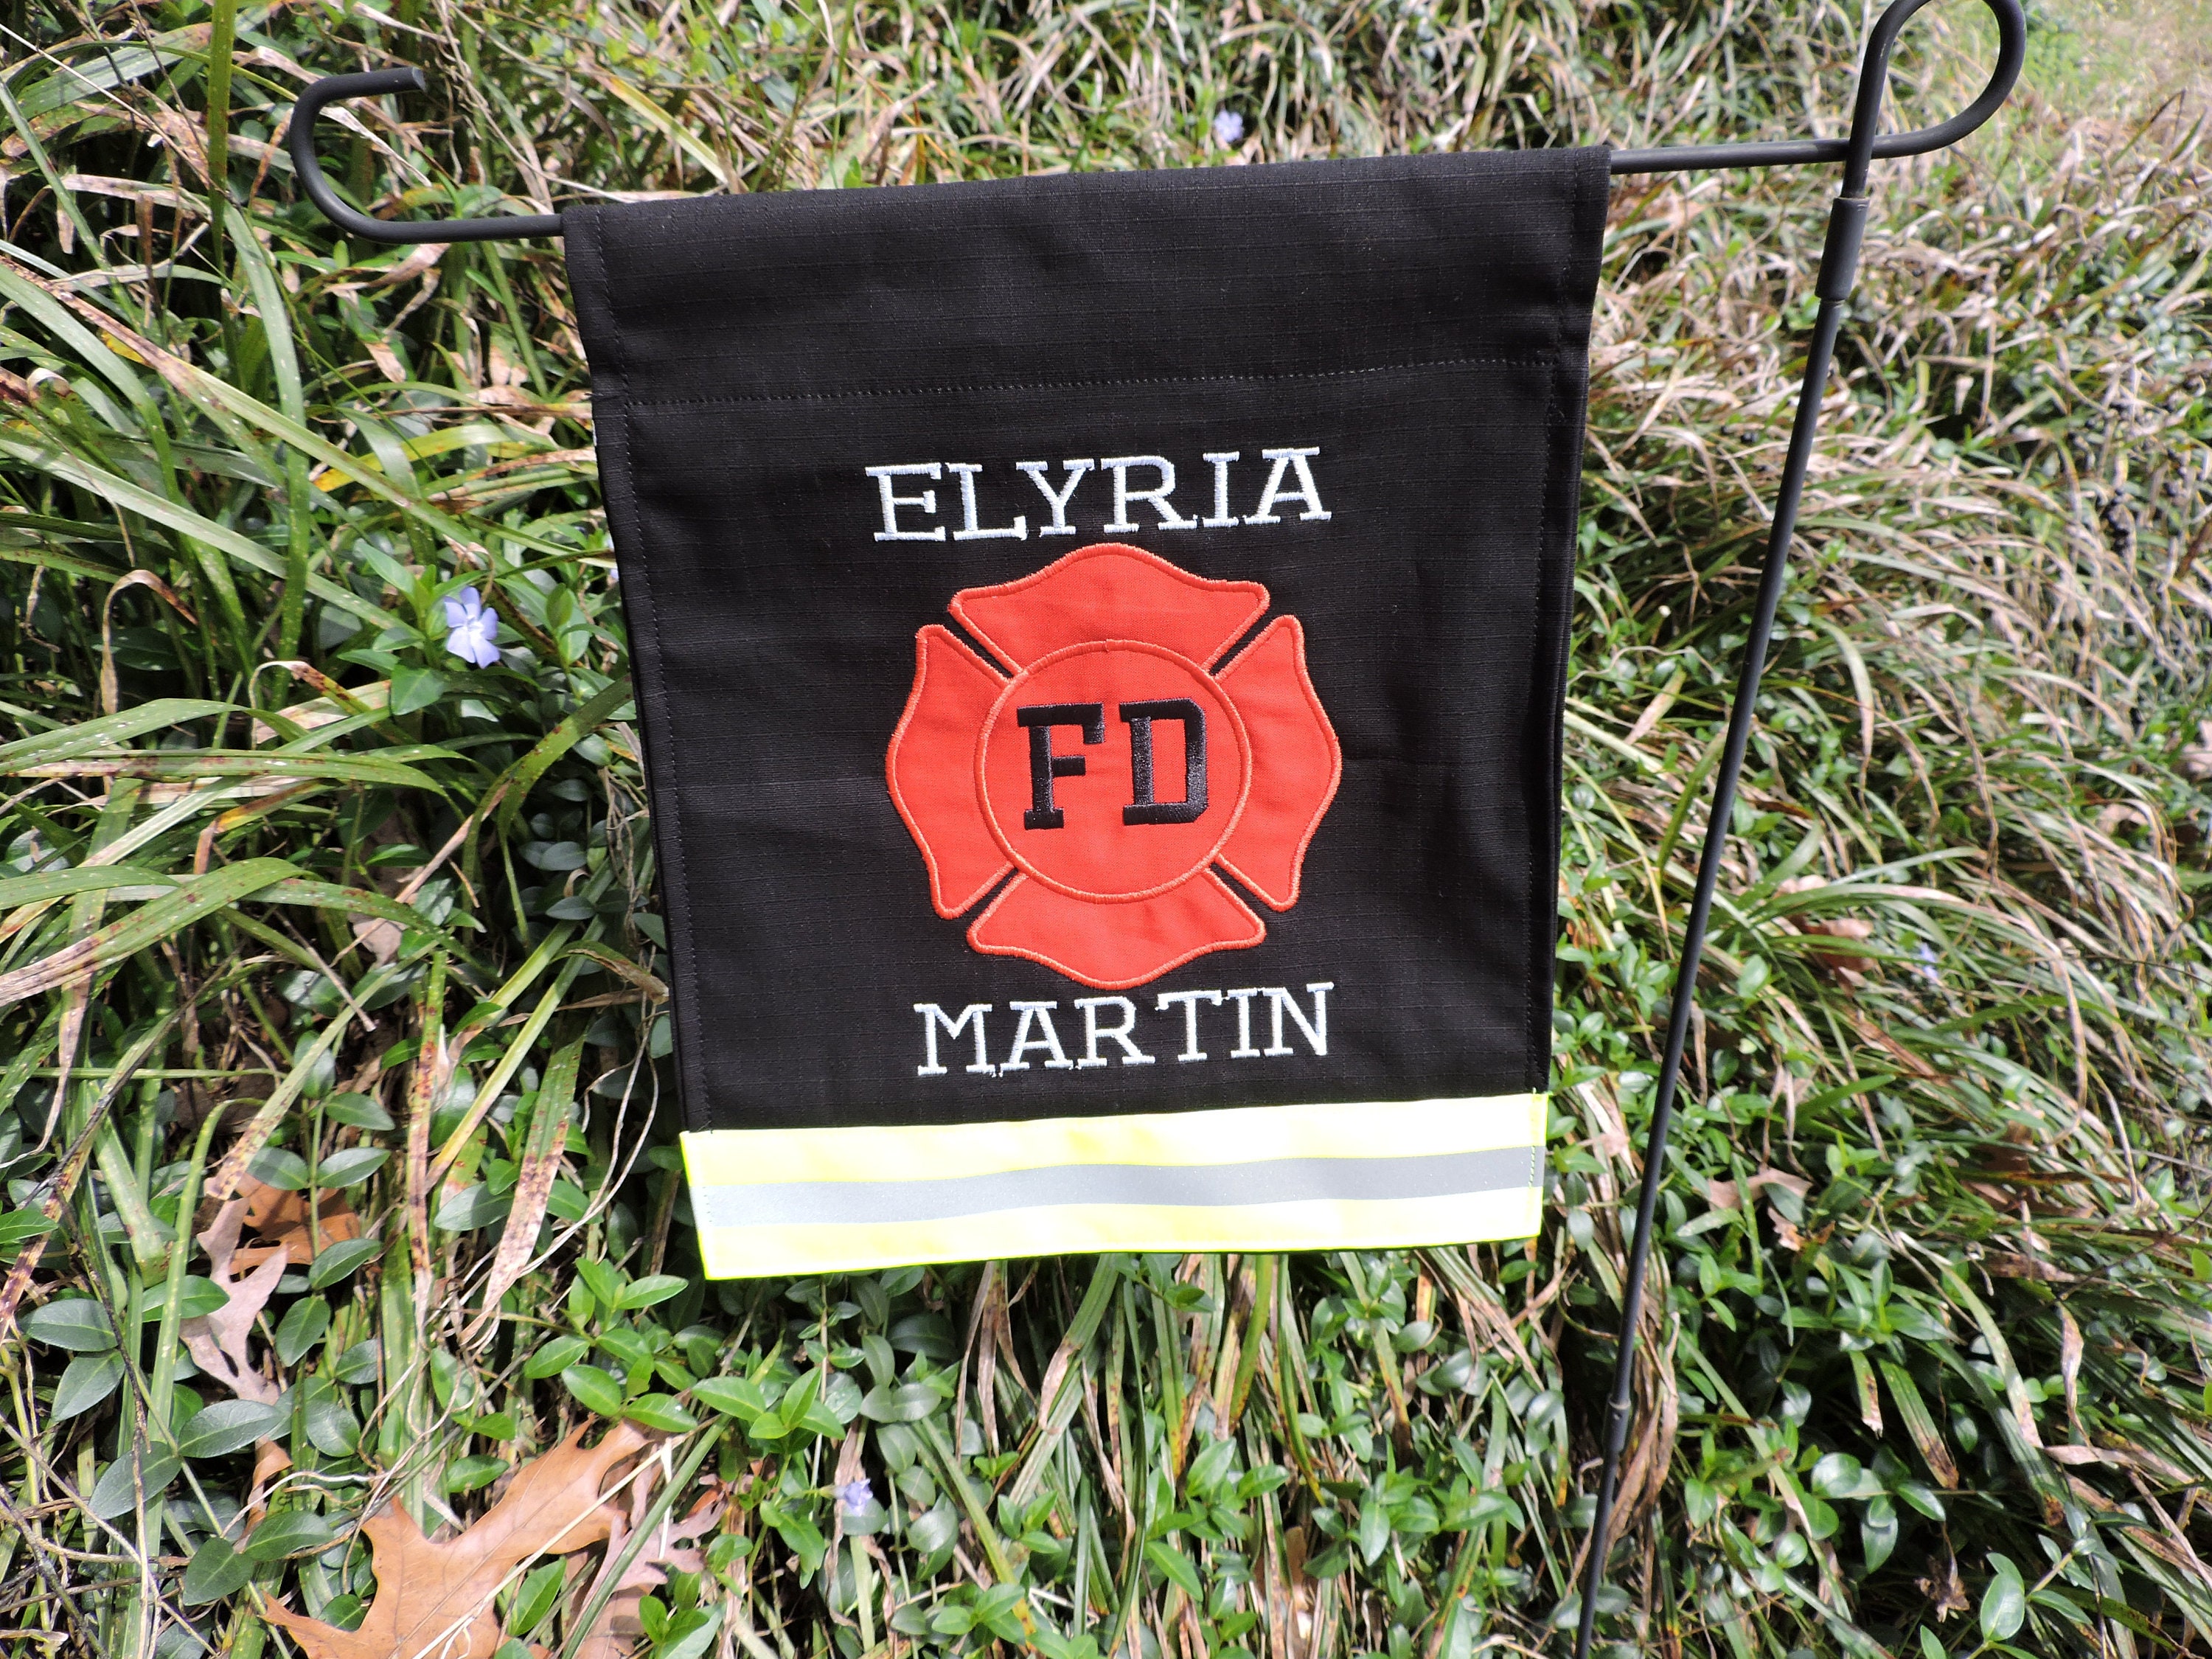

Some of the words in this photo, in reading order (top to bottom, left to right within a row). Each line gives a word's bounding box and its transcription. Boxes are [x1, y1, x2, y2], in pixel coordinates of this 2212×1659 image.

[865, 447, 1332, 541] ELYRIA
[1018, 699, 1208, 830] FD
[914, 981, 1334, 1077] MARTIN
